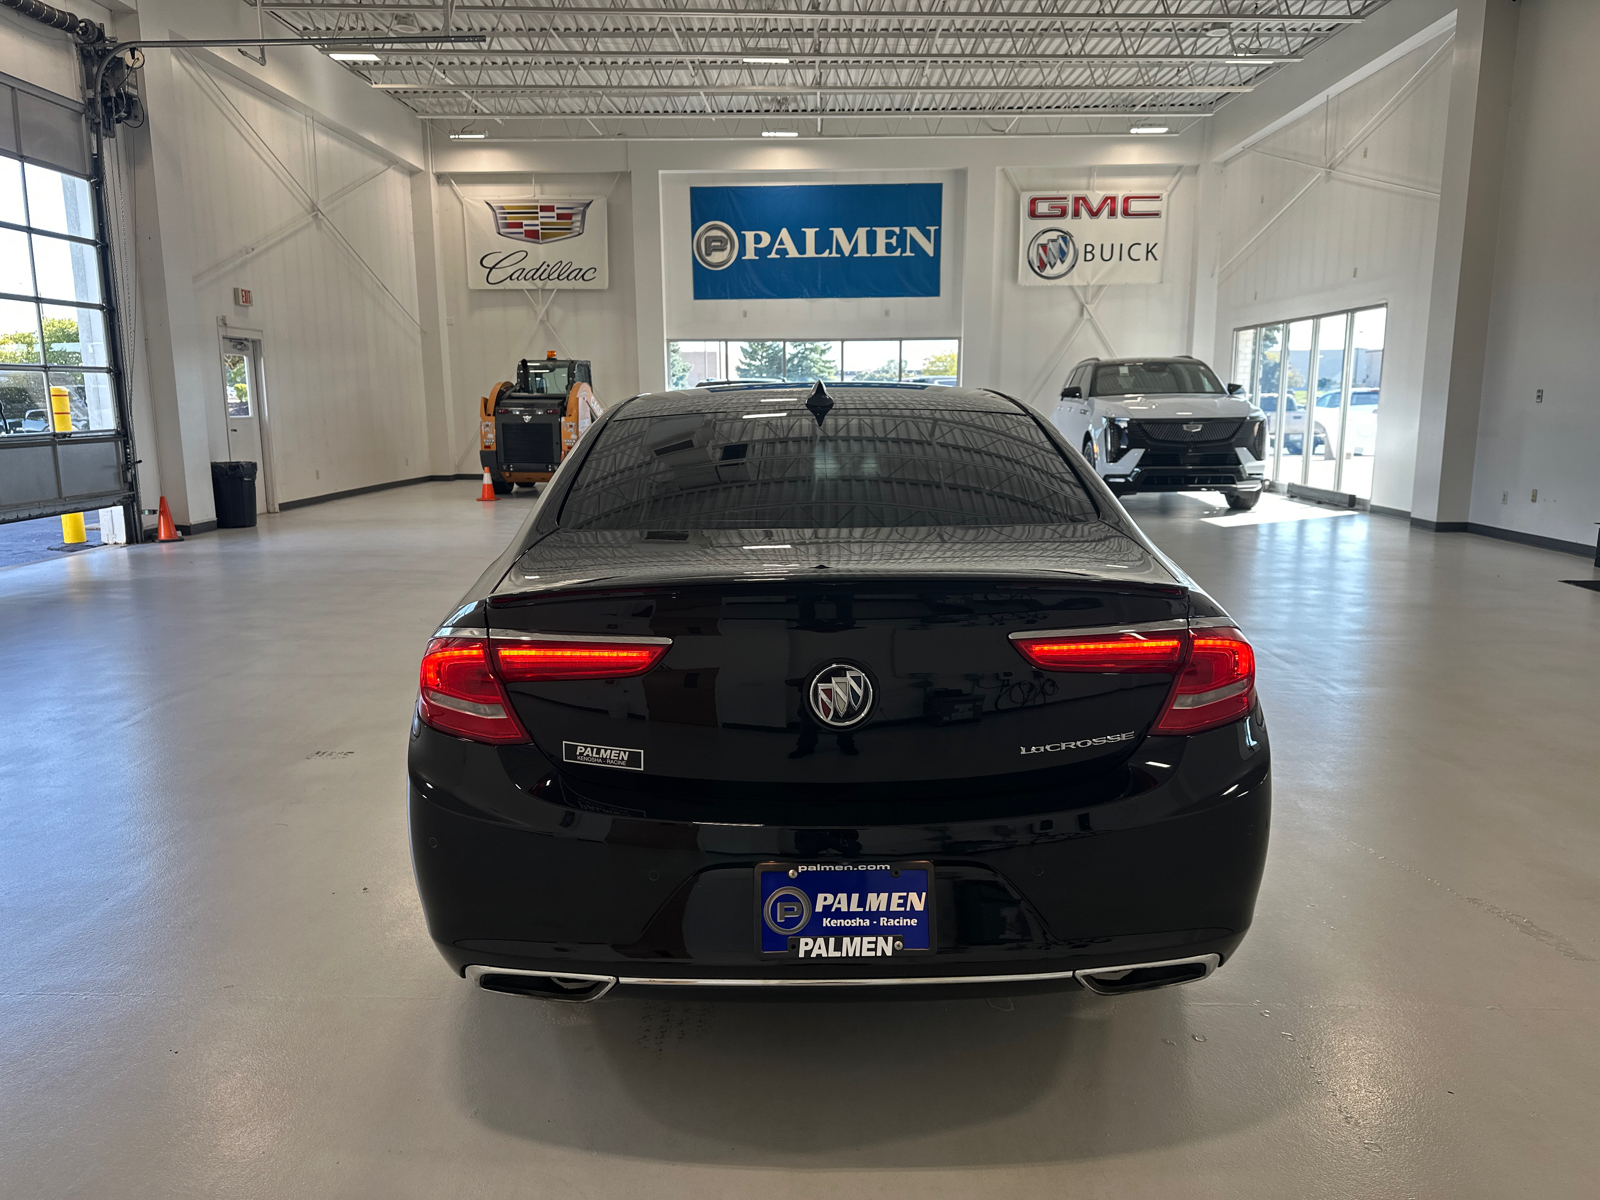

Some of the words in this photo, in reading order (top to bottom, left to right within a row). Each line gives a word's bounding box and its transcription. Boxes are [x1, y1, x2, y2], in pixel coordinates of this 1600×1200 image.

[1028, 194, 1162, 220] GMC
[705, 235, 729, 257] P
[741, 226, 939, 260] PALMEN
[1083, 243, 1158, 262] BUICK
[480, 250, 597, 285] Cadillac
[576, 745, 629, 761] PALMEN
[577, 755, 603, 764] KENOSHA
[798, 864, 891, 873] palmen.com
[777, 902, 801, 922] P
[815, 892, 926, 912] PALMEN
[822, 917, 870, 927] Kenosha
[880, 917, 918, 926] Racine
[798, 936, 893, 957] PALMEN
